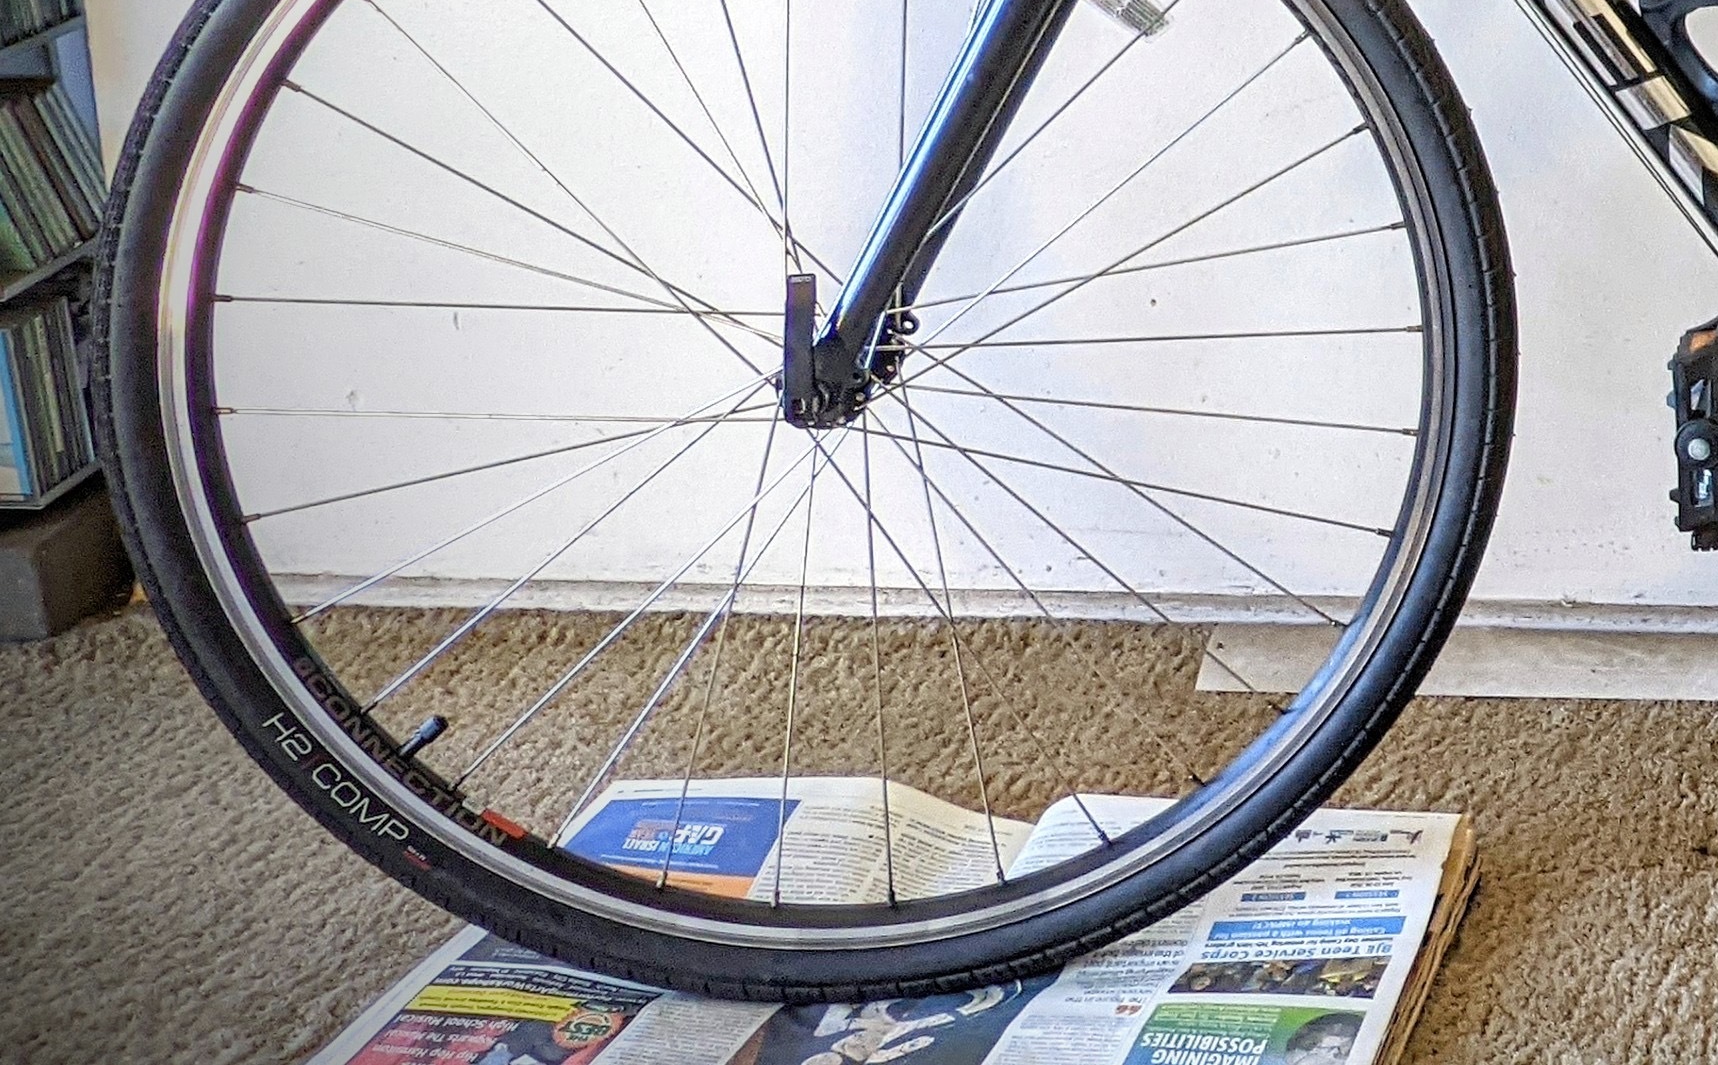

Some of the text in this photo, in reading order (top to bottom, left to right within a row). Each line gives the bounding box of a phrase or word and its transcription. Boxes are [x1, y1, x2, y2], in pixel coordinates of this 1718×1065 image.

[261, 712, 410, 841] H2 COMP
[622, 838, 660, 852] ISRAEL
[657, 841, 715, 855] AMERICN
[1201, 942, 1393, 961] BJE Teen Service Corps
[393, 1014, 519, 1031] High School Musical
[558, 1022, 611, 1037] BEST
[426, 1033, 446, 1042] The
[1140, 1032, 1269, 1055] POSSIBILITIES
[429, 1048, 455, 1059] Hop
[454, 1051, 479, 1062] Hip
[1151, 1049, 1261, 1065] IMAGINING
